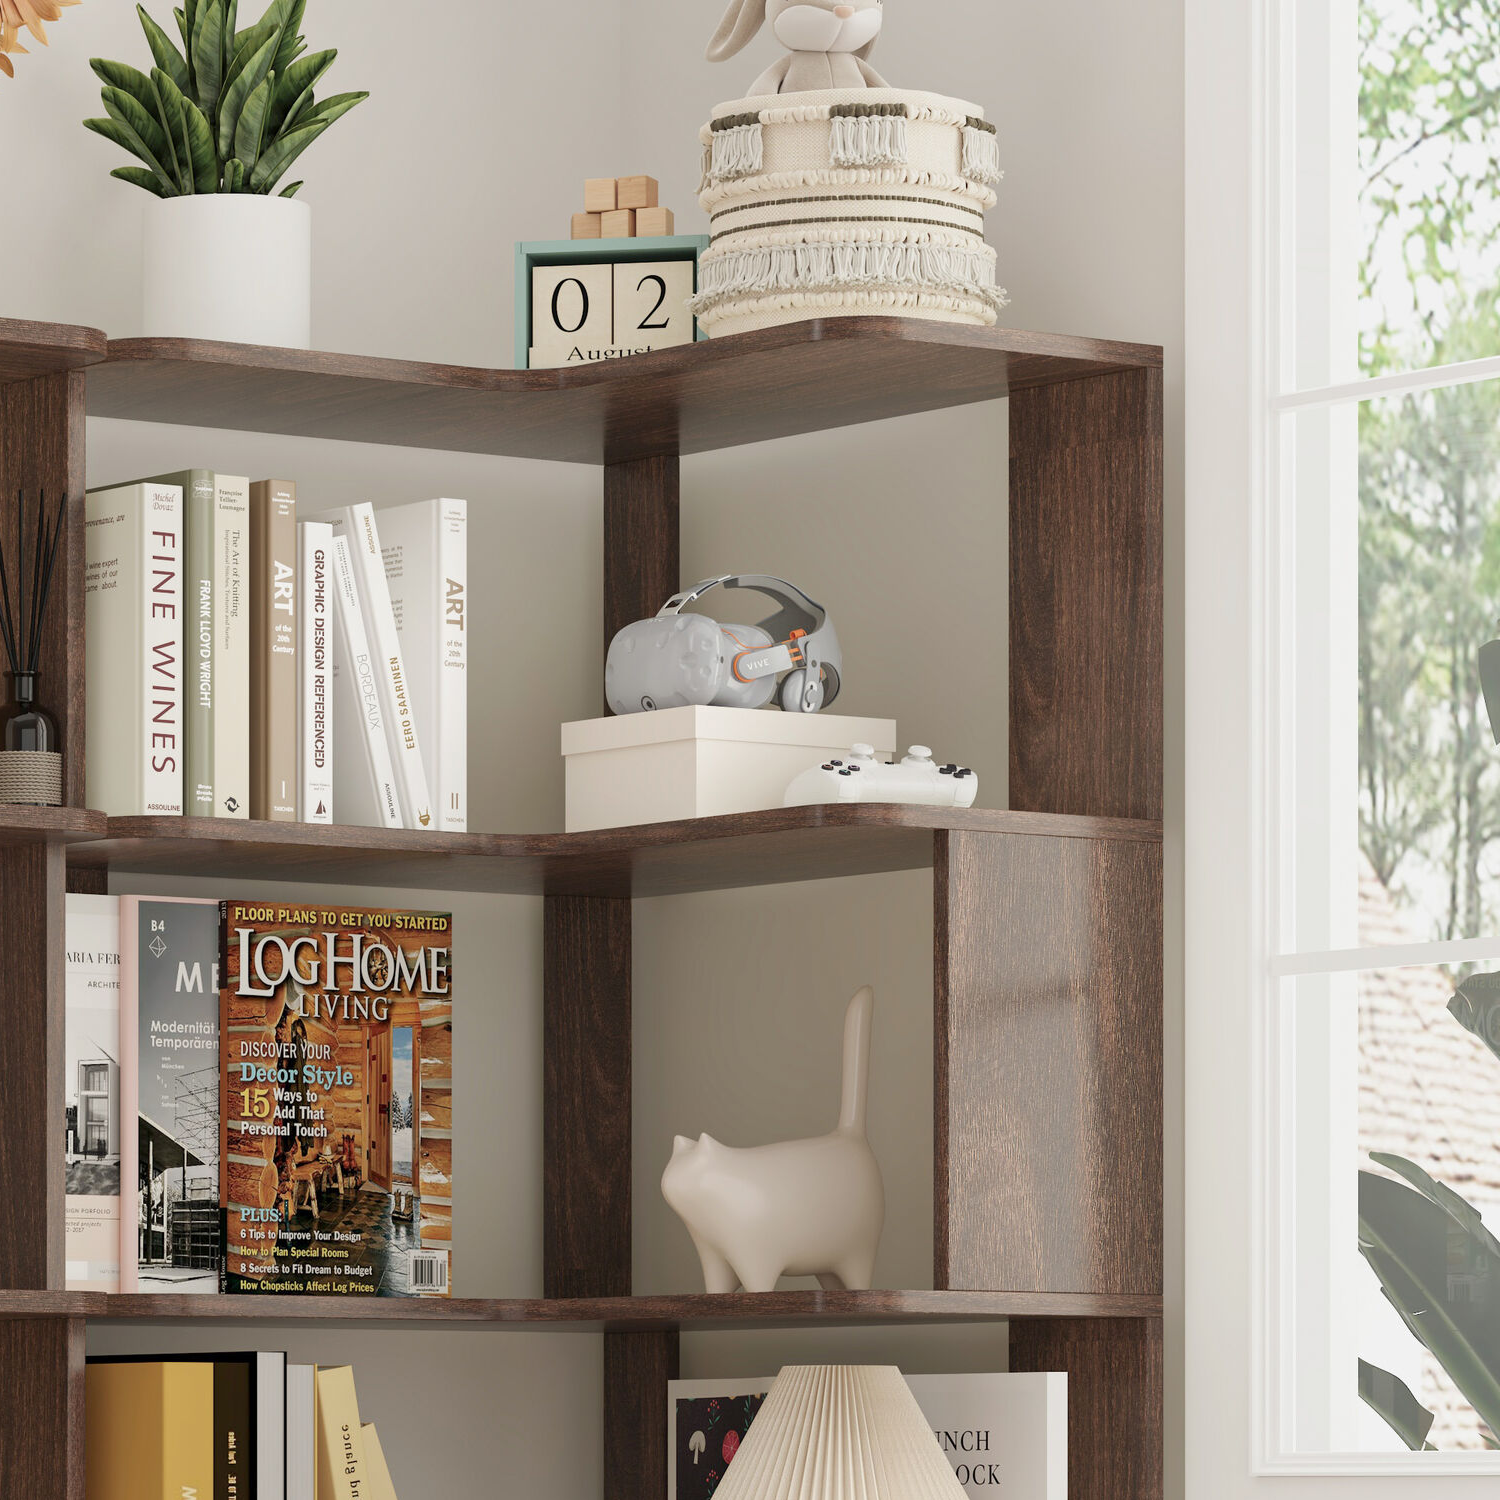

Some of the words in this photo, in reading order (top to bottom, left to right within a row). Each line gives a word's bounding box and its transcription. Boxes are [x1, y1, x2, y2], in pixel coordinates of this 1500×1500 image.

[152, 531, 175, 620] FINE
[274, 560, 293, 616] ART
[315, 550, 325, 613] GRAPHIC
[200, 580, 211, 618] FRANK
[446, 578, 464, 631] ART
[200, 619, 211, 658] LLOYD
[315, 618, 325, 669] DESIGN
[200, 661, 211, 708] WRIGHT
[390, 656, 408, 714] SAARINEN
[746, 658, 770, 670] VIVE
[152, 641, 176, 773] WINES
[357, 654, 380, 730] BORDEAUX
[315, 675, 325, 768] REFERENCED
[402, 720, 415, 750] EERO
[151, 920, 165, 932] B4
[235, 907, 274, 922] FLOOR
[278, 909, 317, 923] PLANS
[321, 911, 337, 925] TO
[340, 912, 363, 926] GET
[368, 914, 391, 928] YOU
[395, 916, 448, 931] STARTED
[240, 1062, 298, 1083] Decor
[303, 1064, 354, 1090] Style
[239, 1087, 271, 1117] 15
[273, 1105, 296, 1119] Add
[300, 1106, 324, 1120] That
[240, 1229, 247, 1238] 6
[249, 1229, 265, 1241] Tips
[268, 1230, 276, 1239] to
[278, 1229, 311, 1241] Improve
[313, 1230, 332, 1240] Your
[334, 1231, 361, 1242] Design
